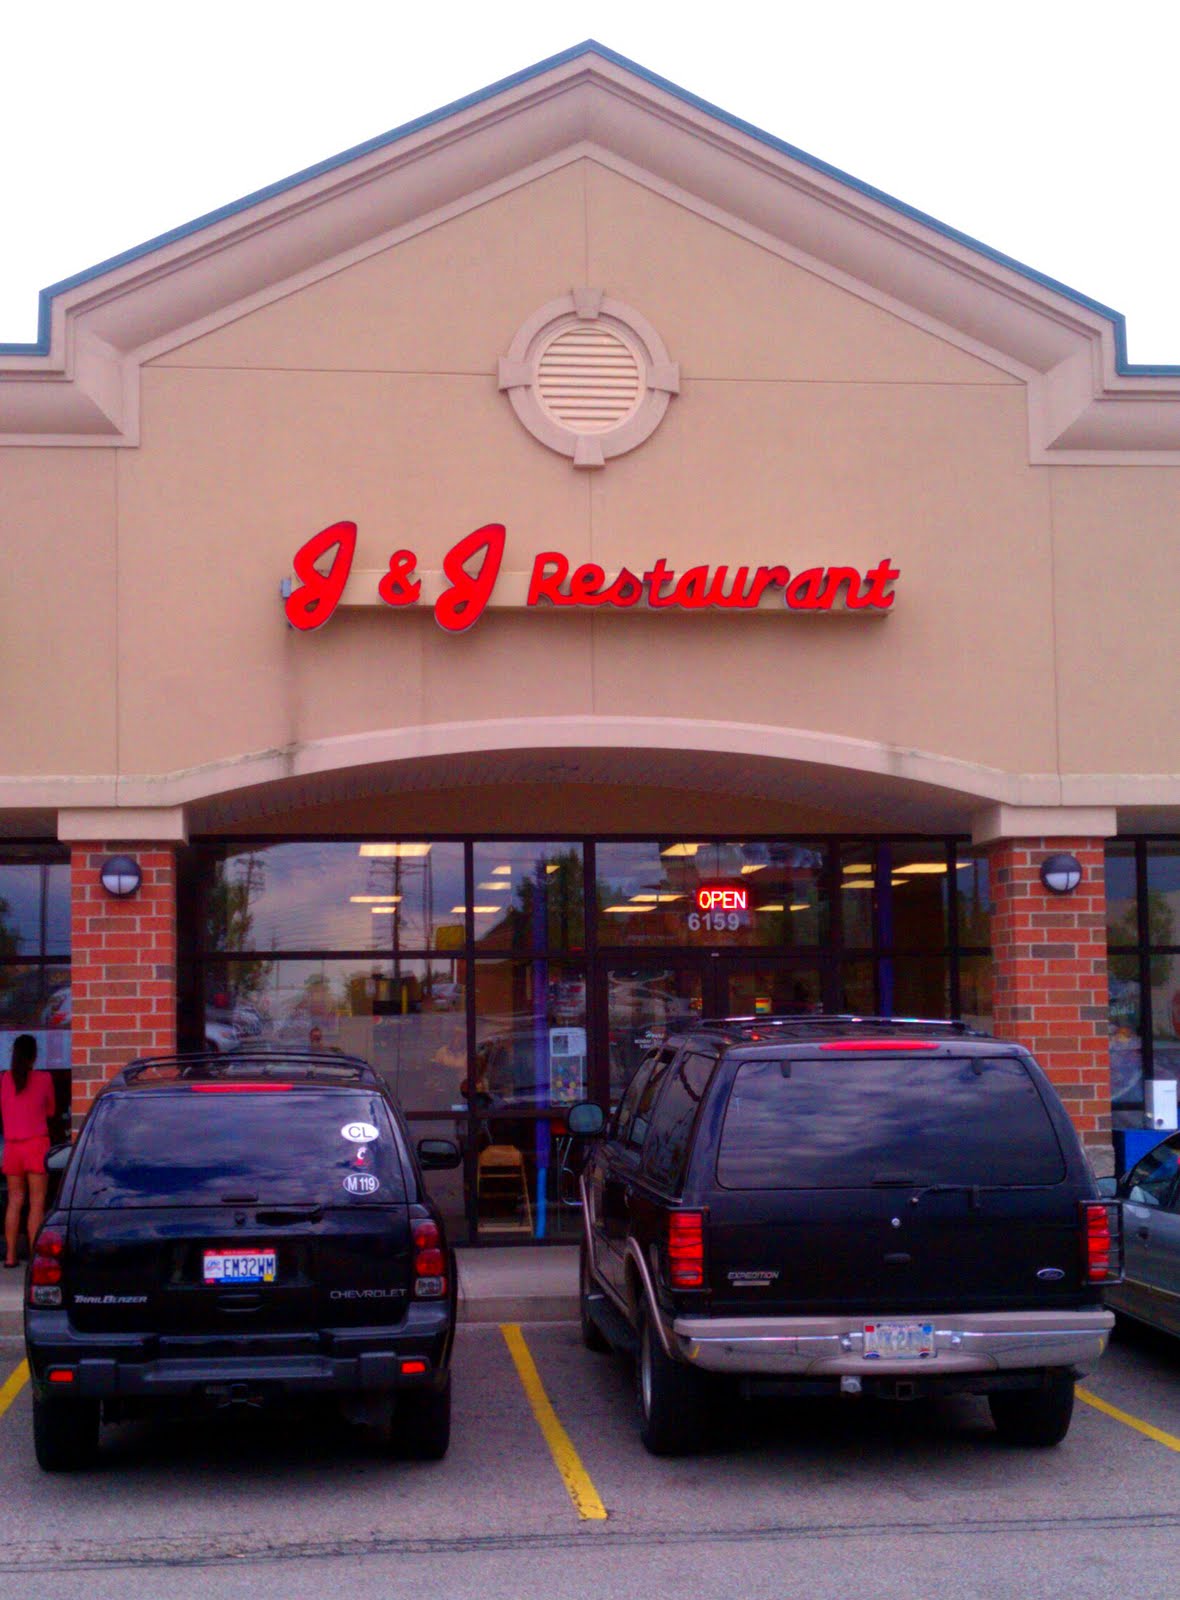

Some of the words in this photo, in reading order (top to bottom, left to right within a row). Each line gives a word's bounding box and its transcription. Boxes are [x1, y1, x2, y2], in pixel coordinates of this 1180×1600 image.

[378, 549, 421, 606] &
[527, 551, 901, 611] Restaurant
[699, 890, 746, 909] OPEN
[688, 912, 740, 931] 6159
[348, 1126, 373, 1138] CL
[727, 1271, 780, 1280] EXPEDITION
[329, 1288, 408, 1300] CHEVROLET
